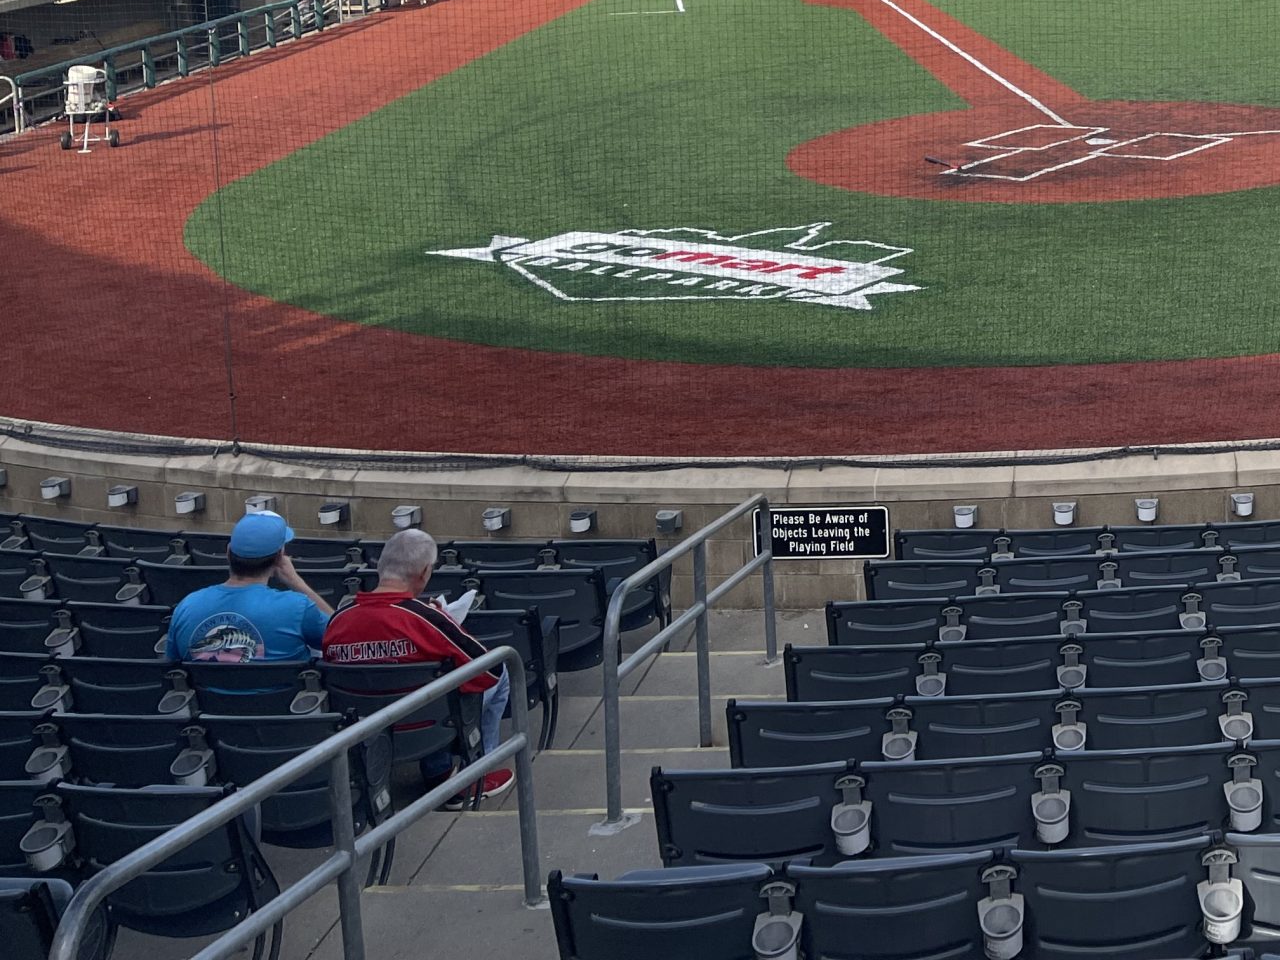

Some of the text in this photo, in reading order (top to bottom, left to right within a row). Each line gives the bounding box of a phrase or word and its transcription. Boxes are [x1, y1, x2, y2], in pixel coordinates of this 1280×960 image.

[554, 242, 848, 280] gomart
[524, 256, 778, 295] BALLPARK
[773, 512, 868, 525] Please Be Aware of
[772, 526, 870, 541] Objects Leaving the
[789, 540, 855, 555] Playing Field
